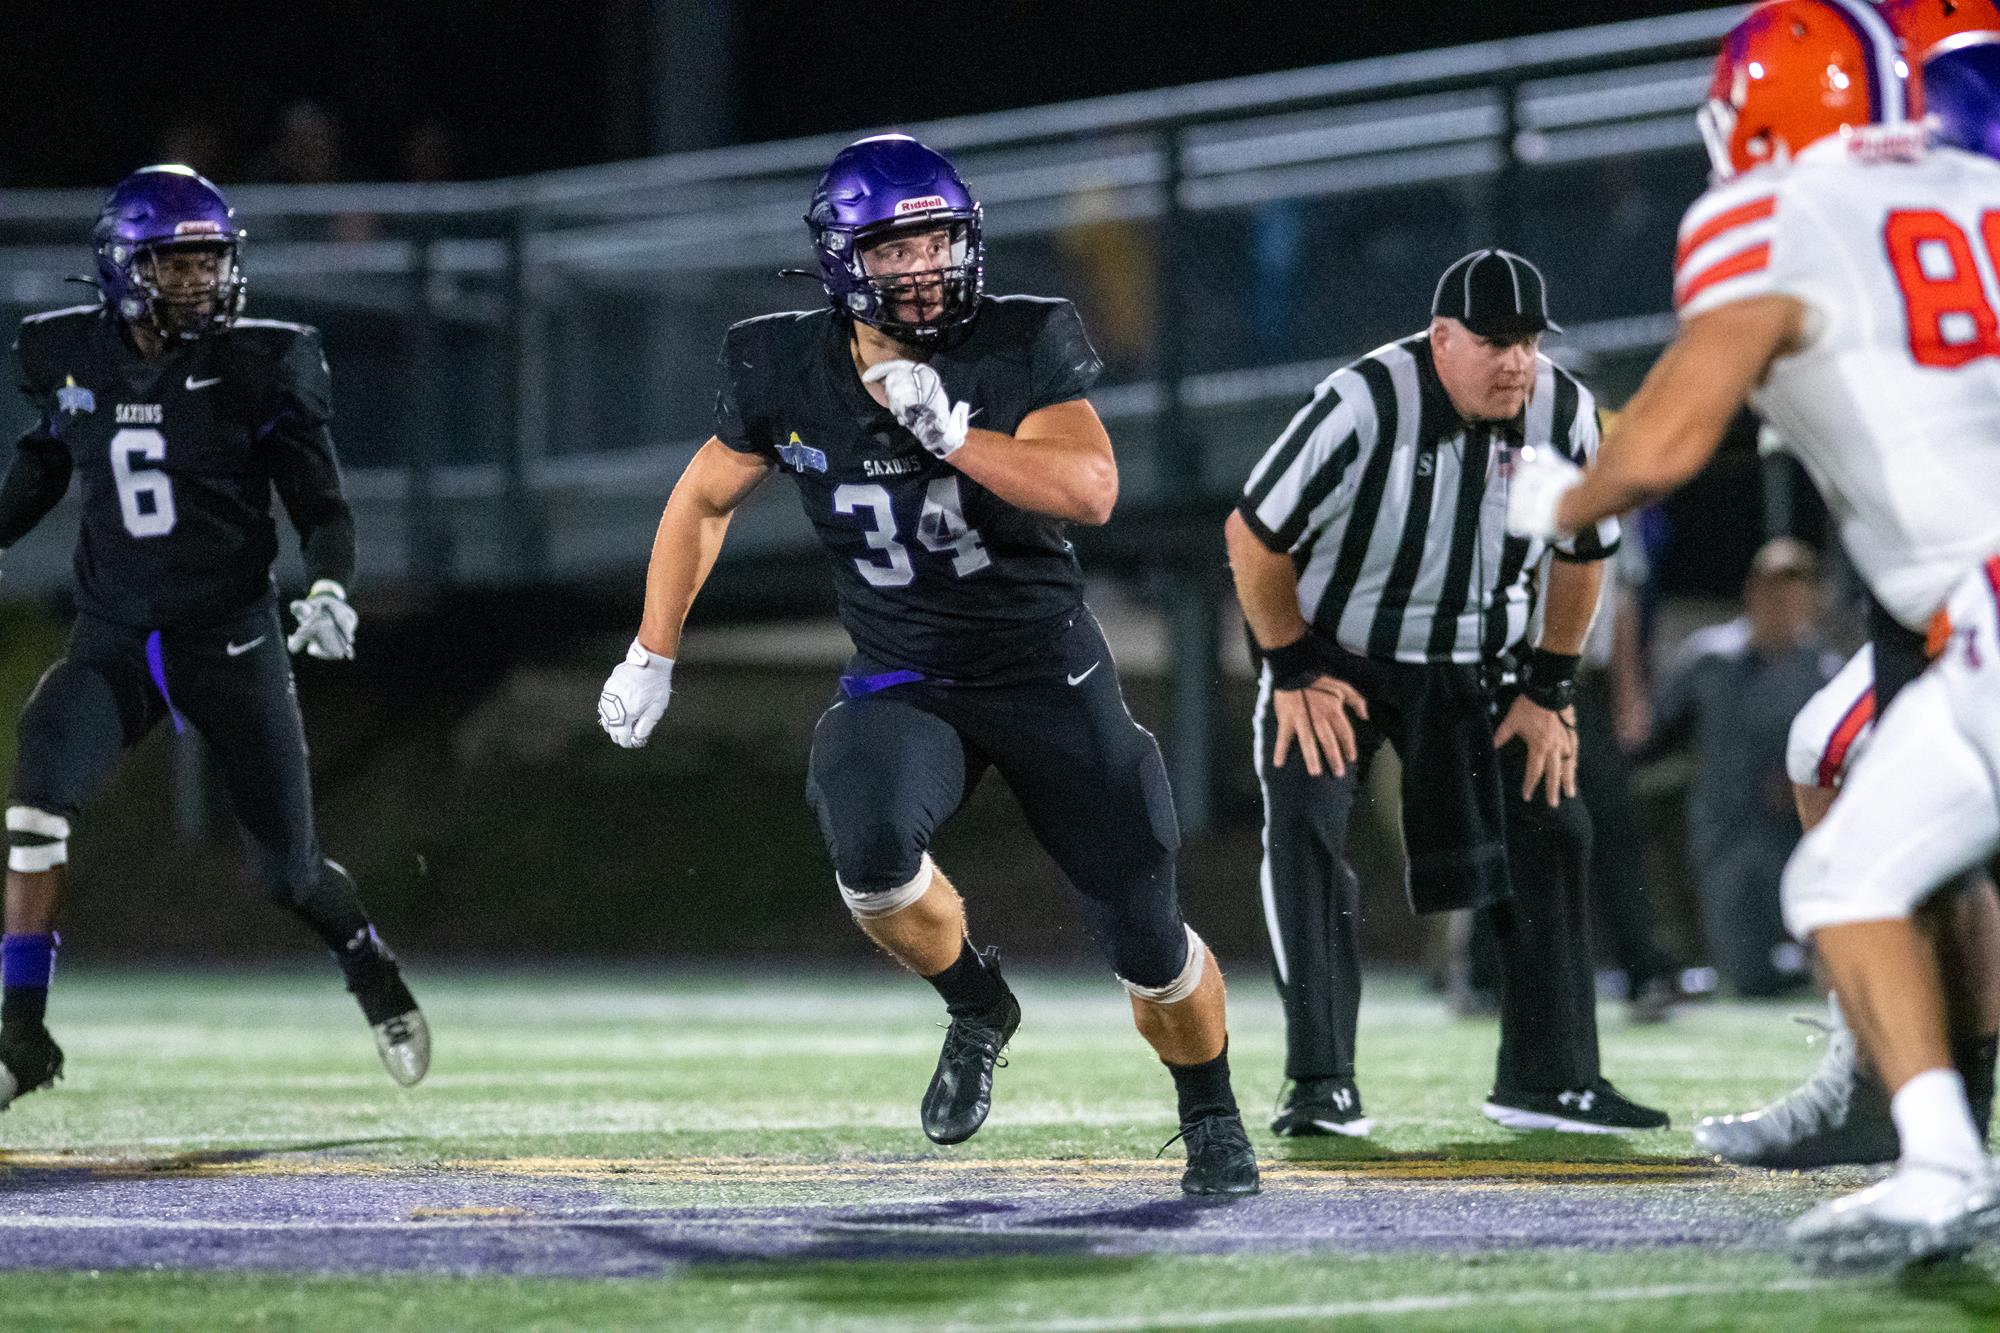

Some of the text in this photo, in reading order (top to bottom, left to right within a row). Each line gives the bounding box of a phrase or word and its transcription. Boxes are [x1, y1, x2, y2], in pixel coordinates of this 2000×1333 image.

[902, 198, 942, 211] Riddell
[1881, 208, 2000, 369] 8
[115, 403, 163, 423] SAXONS
[863, 455, 921, 477] SAXONS
[1416, 452, 1433, 476] S
[110, 428, 177, 538] 6
[832, 475, 991, 586] 34
